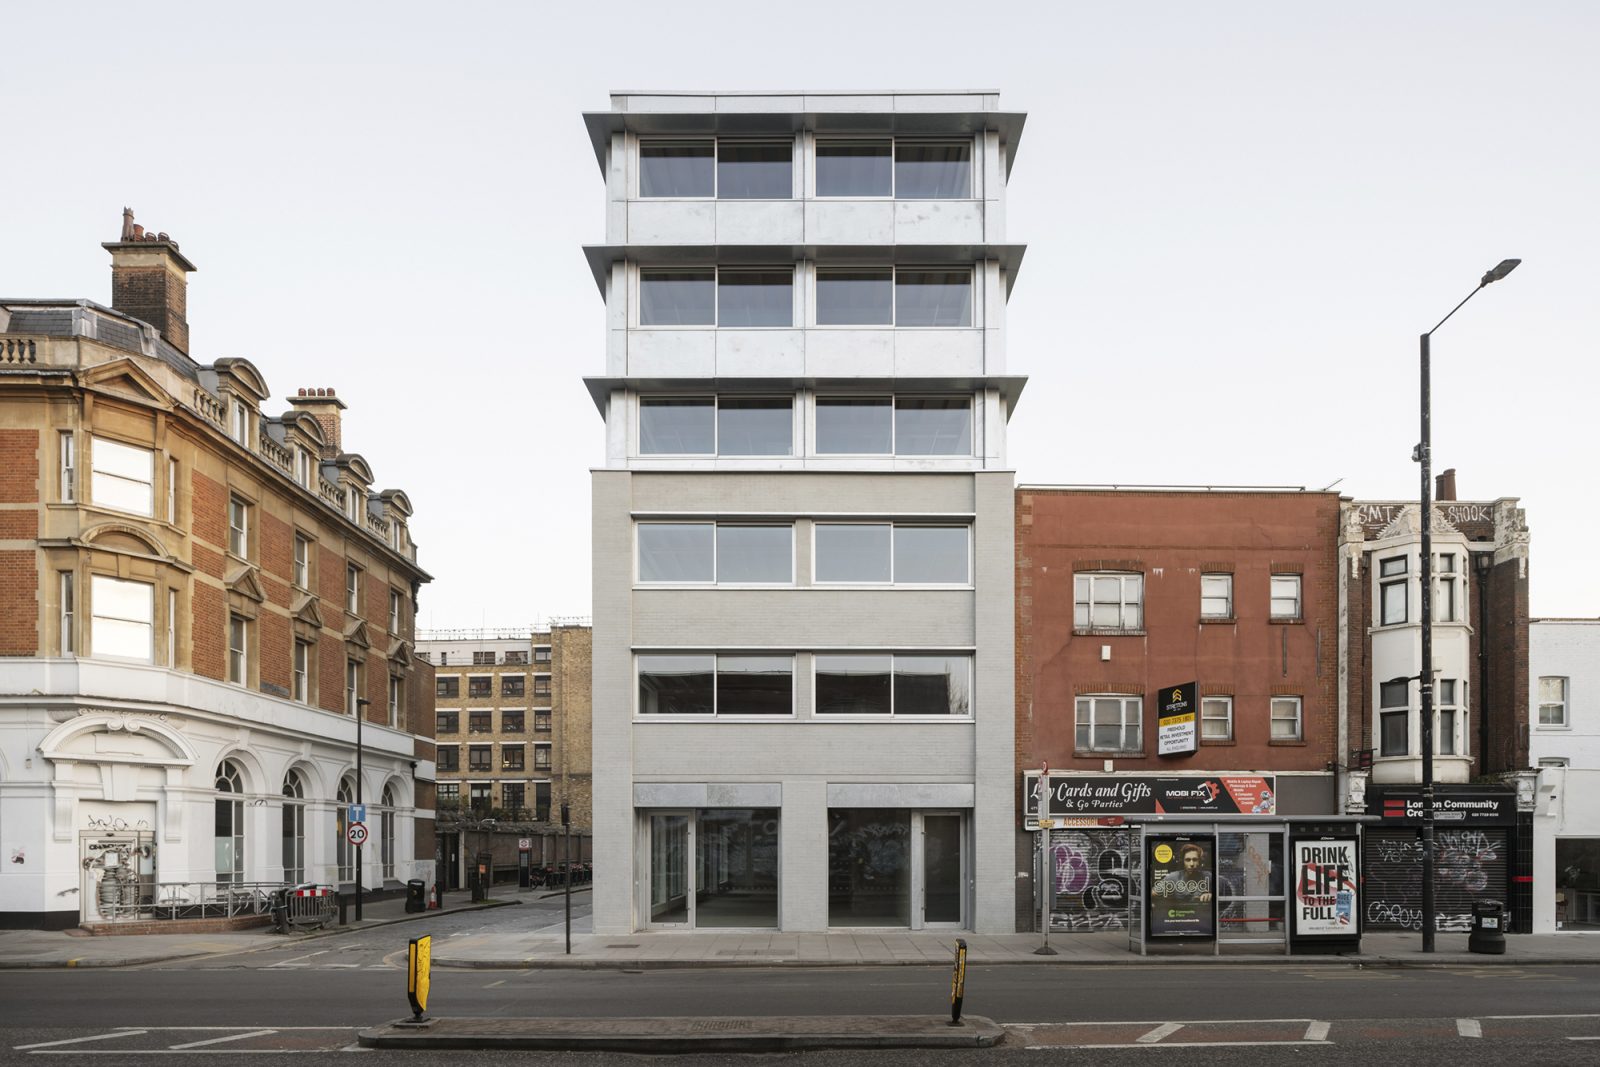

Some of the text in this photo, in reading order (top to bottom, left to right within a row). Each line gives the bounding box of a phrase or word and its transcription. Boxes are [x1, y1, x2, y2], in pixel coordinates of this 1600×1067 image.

[1057, 782, 1092, 801] Cards
[1095, 782, 1119, 797] and
[1121, 782, 1152, 802] Gifts
[1066, 799, 1124, 810] & Go Parties
[1407, 800, 1499, 810] Lonon Community
[350, 829, 365, 839] 20
[1301, 846, 1349, 864] DRINK
[1302, 864, 1350, 895] LIFE
[1154, 876, 1210, 898] speed
[1302, 896, 1336, 906] TO THE
[1302, 907, 1335, 920] FULL
